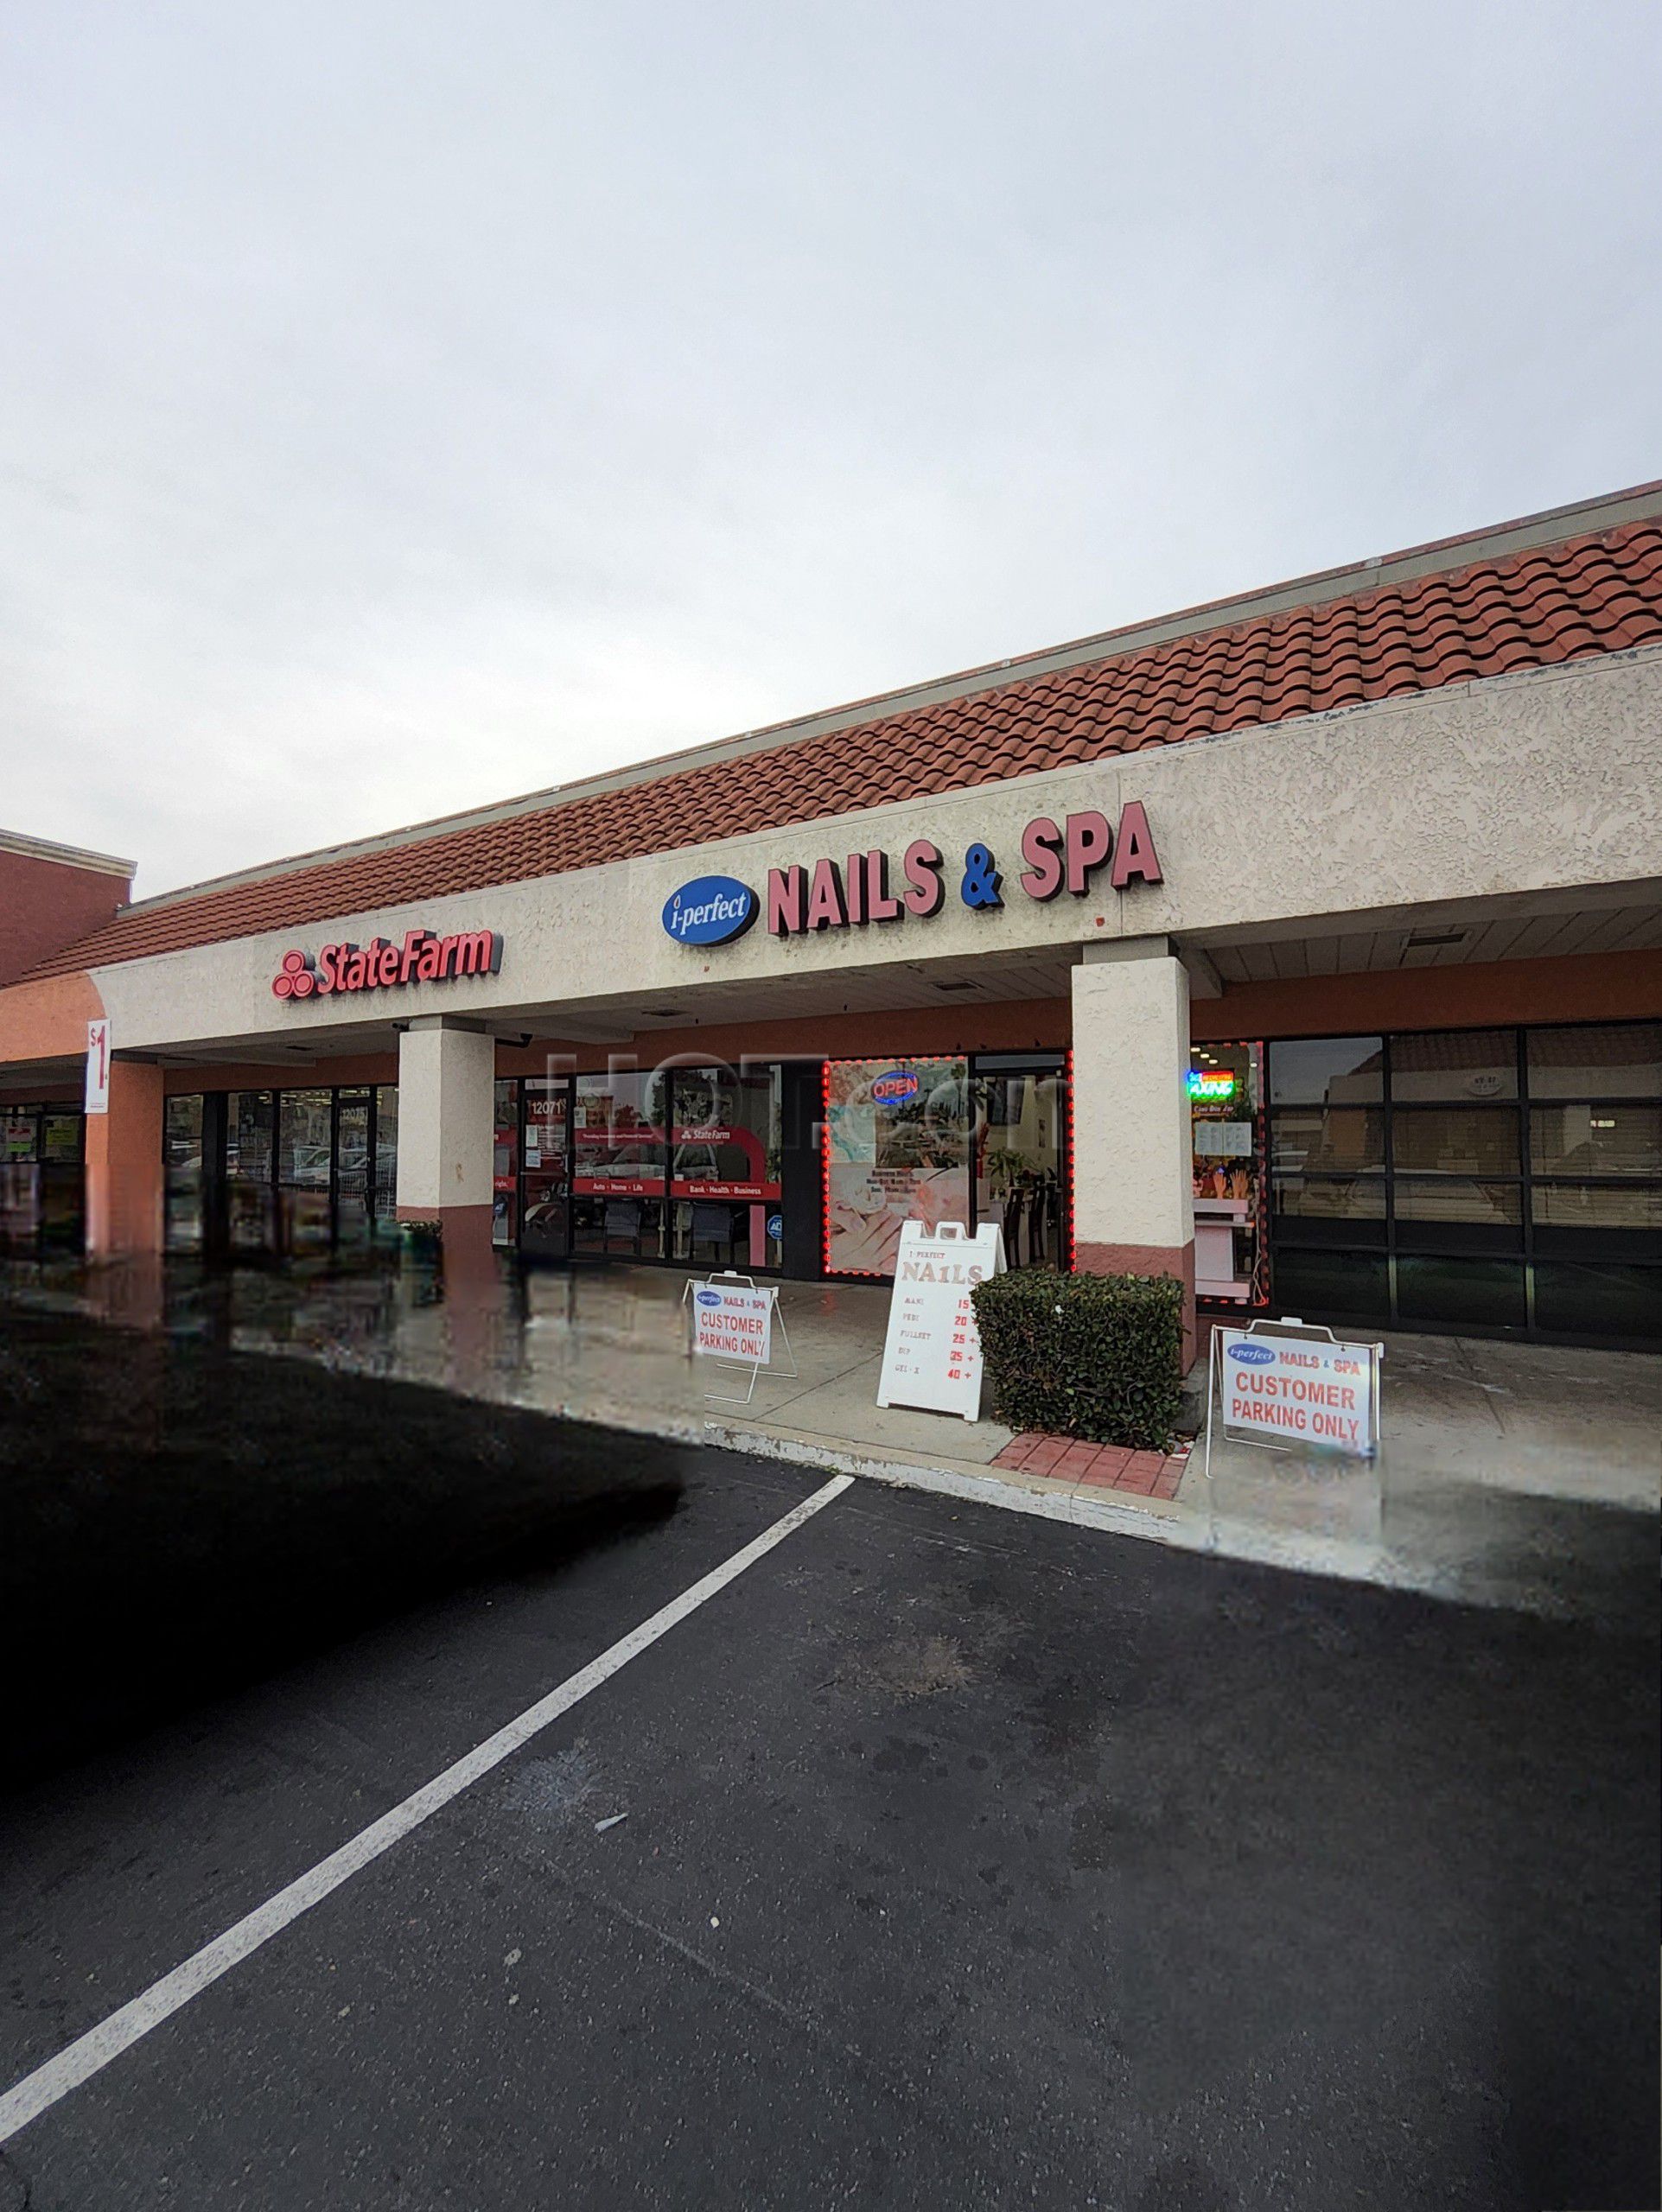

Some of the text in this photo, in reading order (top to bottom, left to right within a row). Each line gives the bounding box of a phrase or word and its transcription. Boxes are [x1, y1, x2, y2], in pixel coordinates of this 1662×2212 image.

[671, 800, 1163, 936] i-perfect NAILS & SPA
[873, 1077, 919, 1097] OPEN
[532, 1100, 561, 1115] 12071
[709, 1185, 729, 1194] Health
[734, 1186, 762, 1195] Business
[916, 1251, 946, 1260] PERFECT
[723, 1296, 745, 1308] NAILS
[752, 1299, 767, 1311] SPA
[958, 1299, 970, 1310] 15
[701, 1312, 763, 1335] CUSTOMER
[954, 1315, 967, 1326] 20
[699, 1332, 766, 1357] PARKING ONLY
[952, 1333, 965, 1344] 25
[950, 1351, 963, 1362] 35
[1230, 1345, 1273, 1362] i-perfect
[1279, 1351, 1320, 1370] NAILS
[1334, 1358, 1361, 1376] SPA
[947, 1369, 961, 1380] 40
[1235, 1371, 1356, 1411] CUSTOMER
[1232, 1398, 1360, 1440] PARKING ONLY
